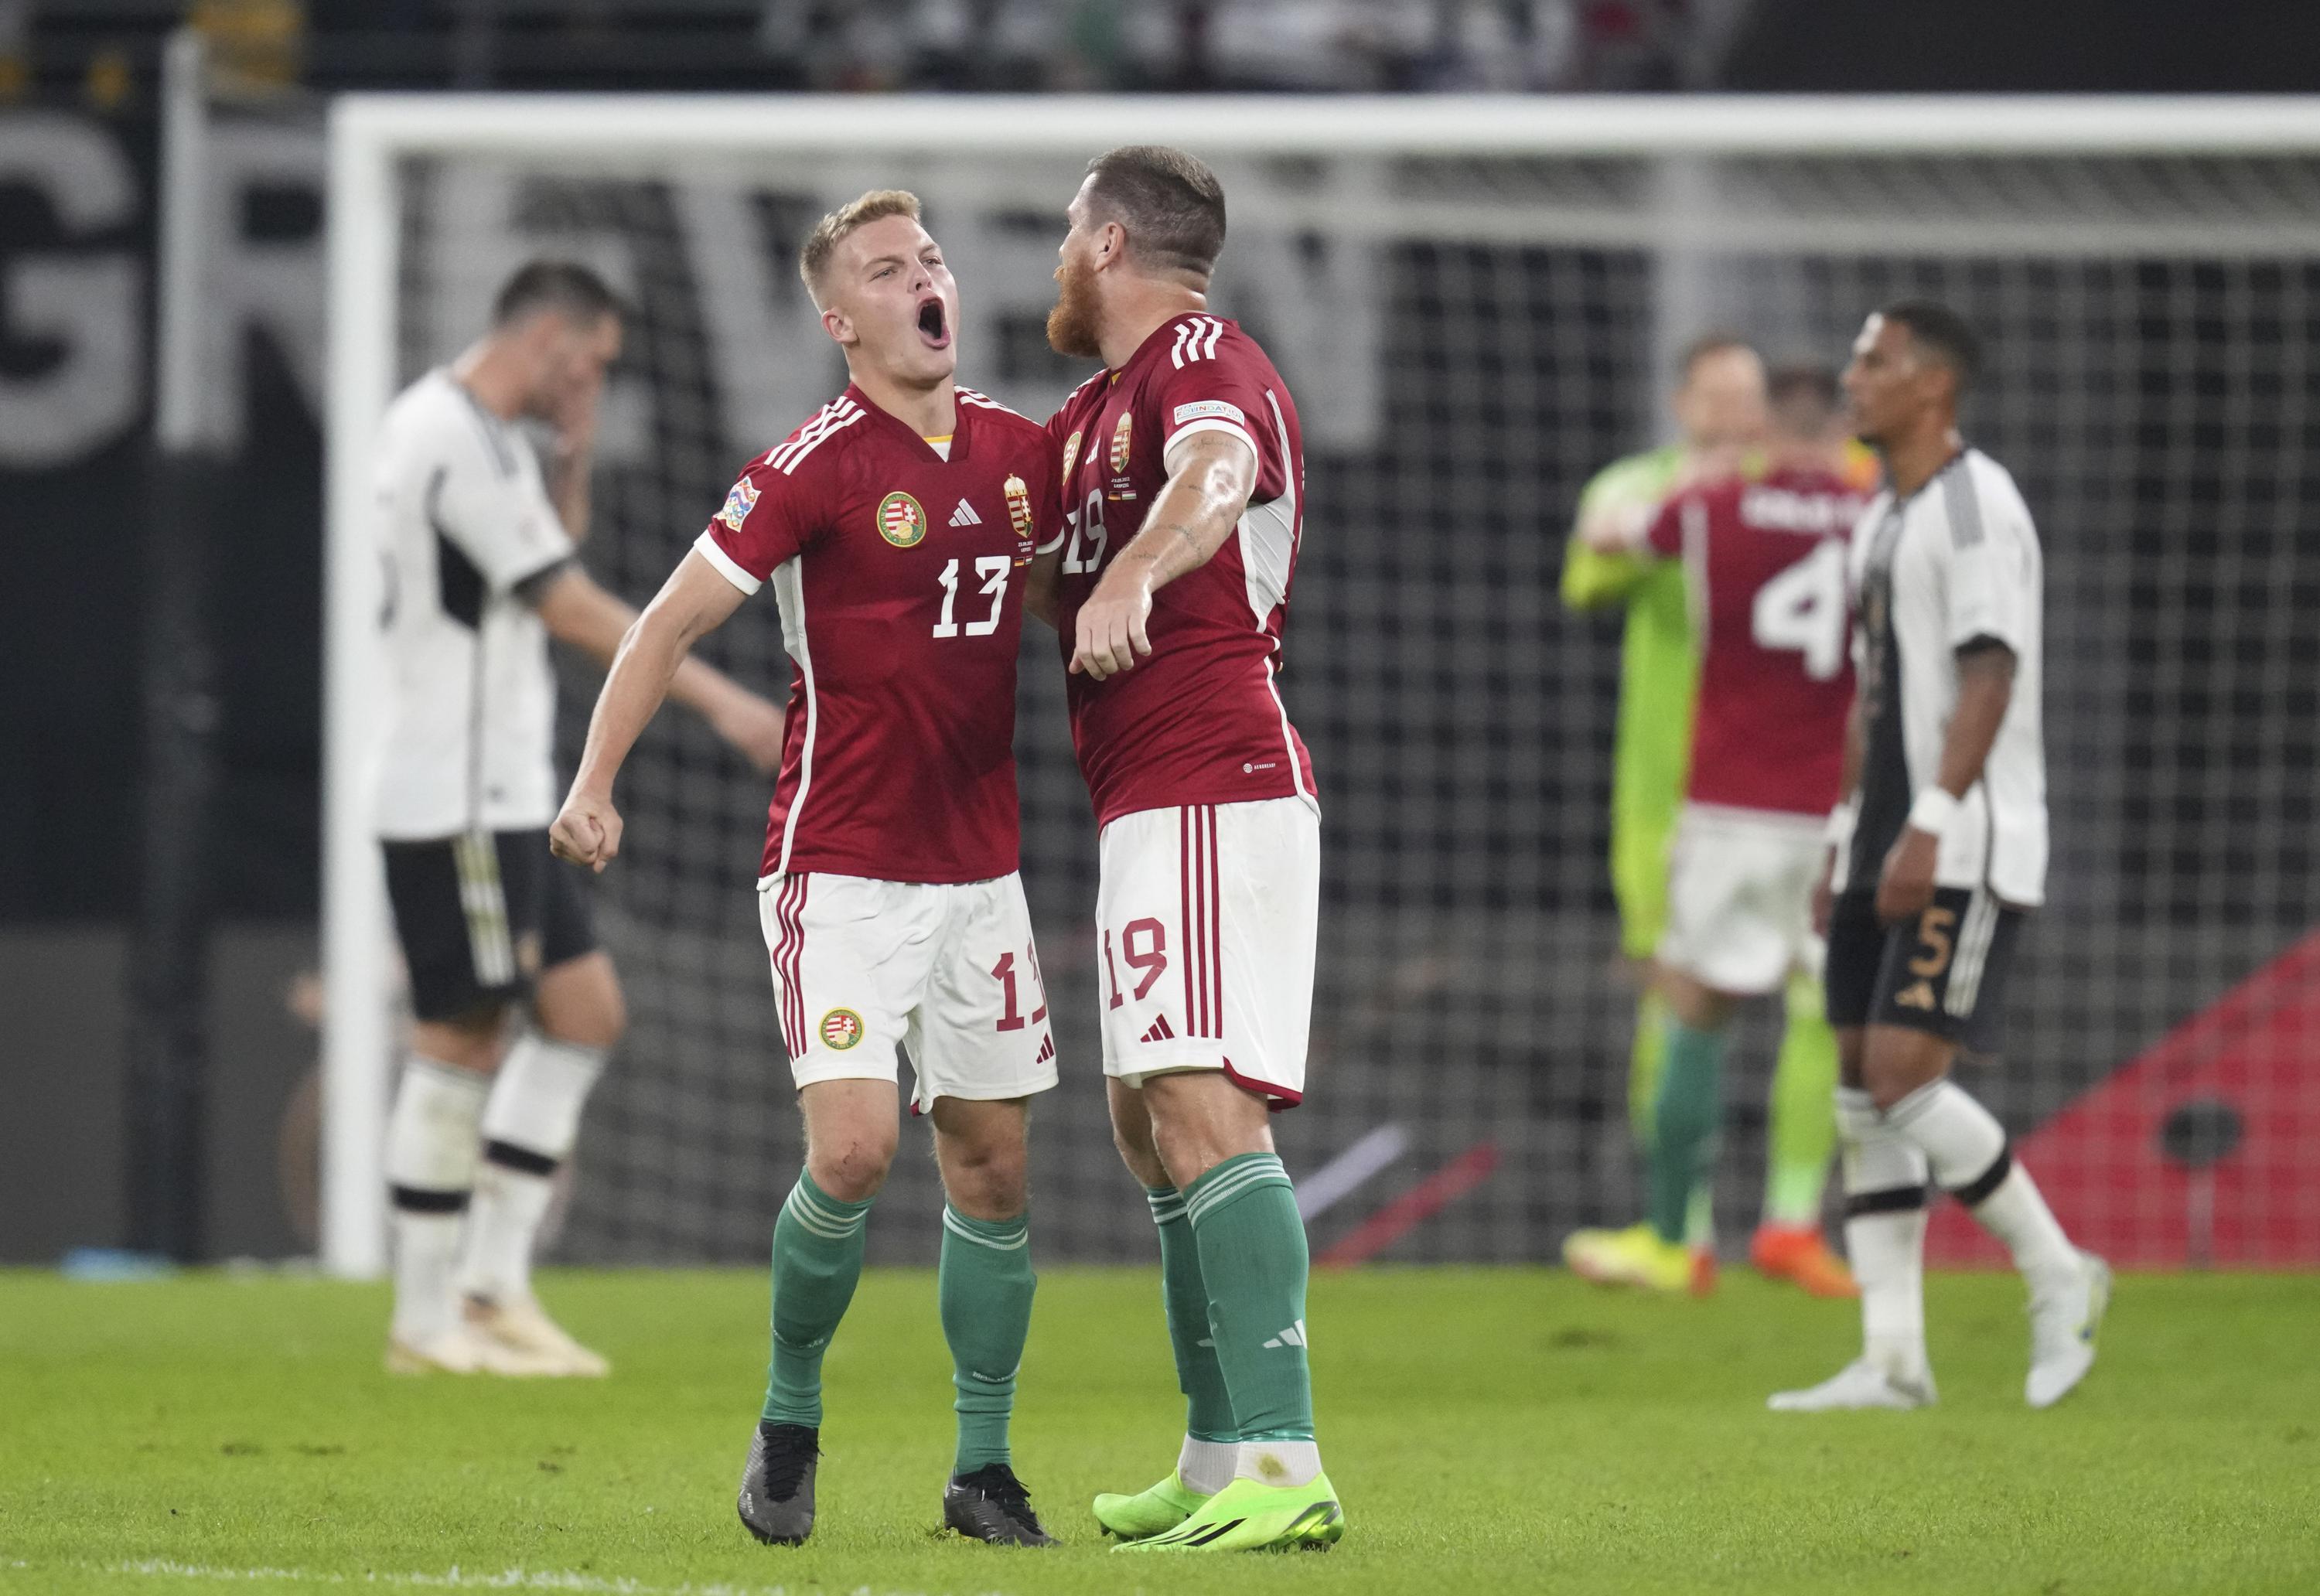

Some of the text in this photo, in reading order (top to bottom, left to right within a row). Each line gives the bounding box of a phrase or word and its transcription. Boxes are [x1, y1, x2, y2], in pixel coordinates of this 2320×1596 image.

[1062, 488, 1107, 575] 19
[933, 556, 1011, 638] 13
[1751, 538, 1847, 681] 4
[1104, 917, 1166, 1011] 19
[1909, 906, 1957, 978] 5
